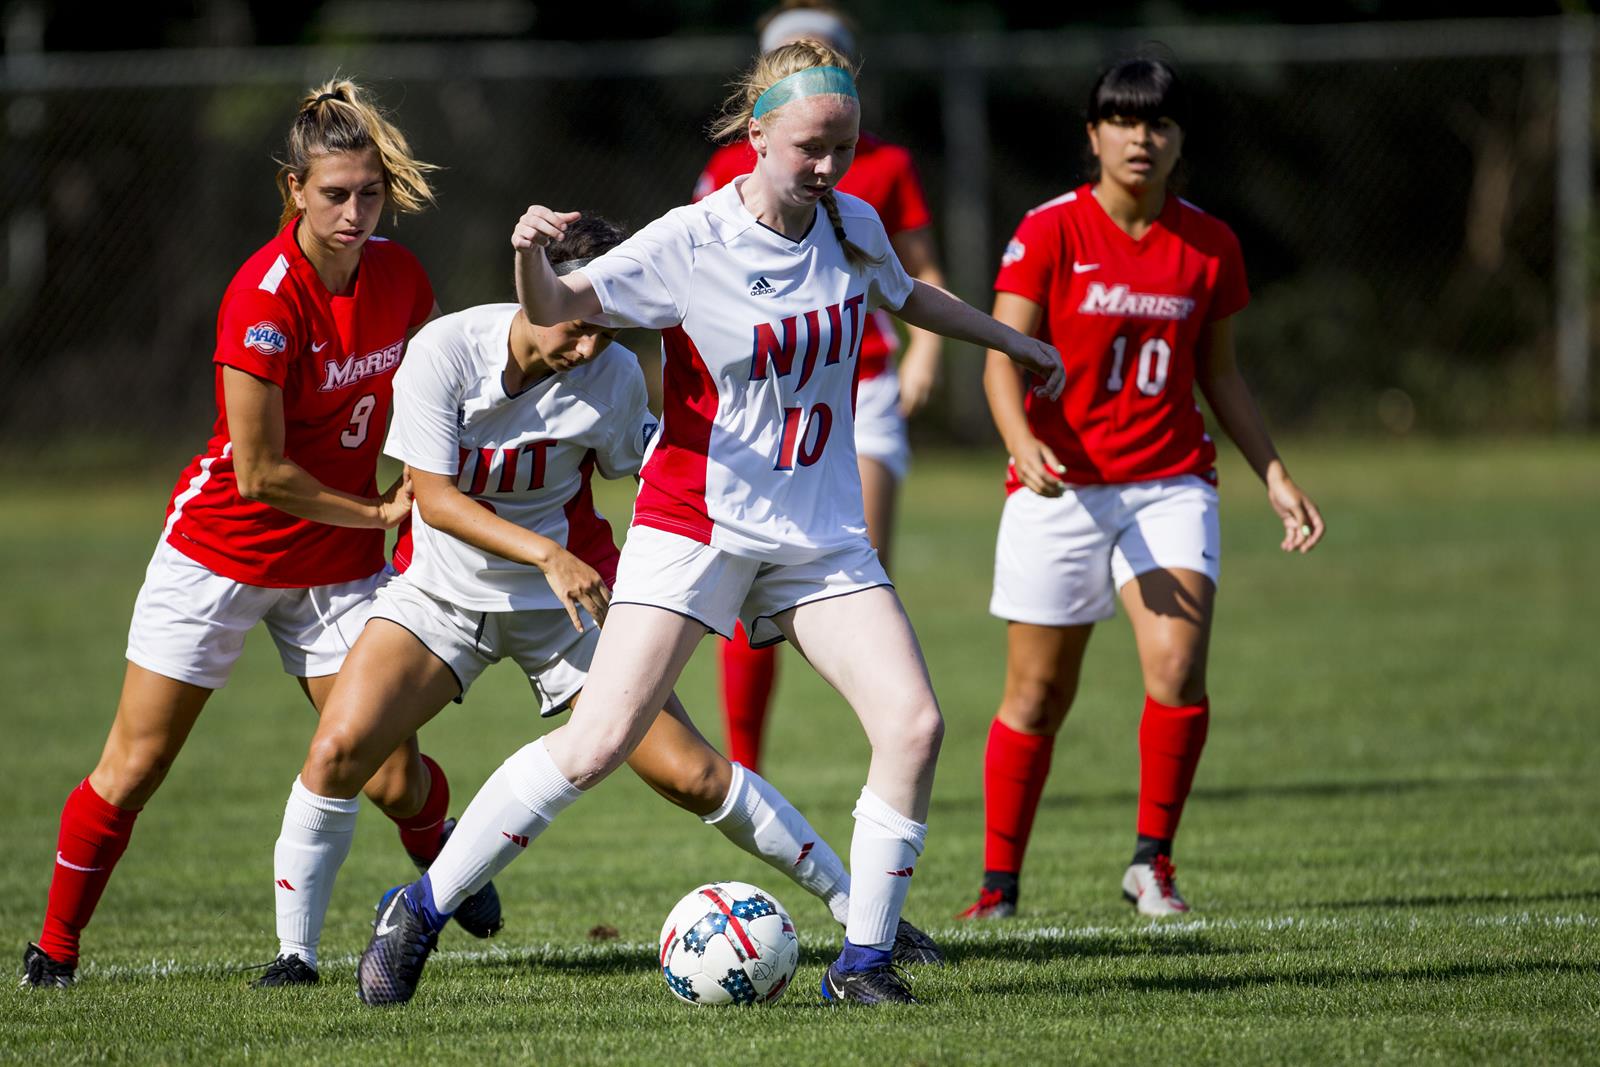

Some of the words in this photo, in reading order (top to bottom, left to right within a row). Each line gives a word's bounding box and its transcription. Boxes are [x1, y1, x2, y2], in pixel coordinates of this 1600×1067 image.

[751, 287, 777, 296] adidas
[1078, 281, 1195, 319] MARIST
[246, 327, 286, 349] MAAC
[748, 293, 865, 394] NJIT
[318, 340, 404, 392] MARIST
[1107, 336, 1171, 396] 10
[340, 393, 376, 448] 9
[772, 402, 833, 471] 10
